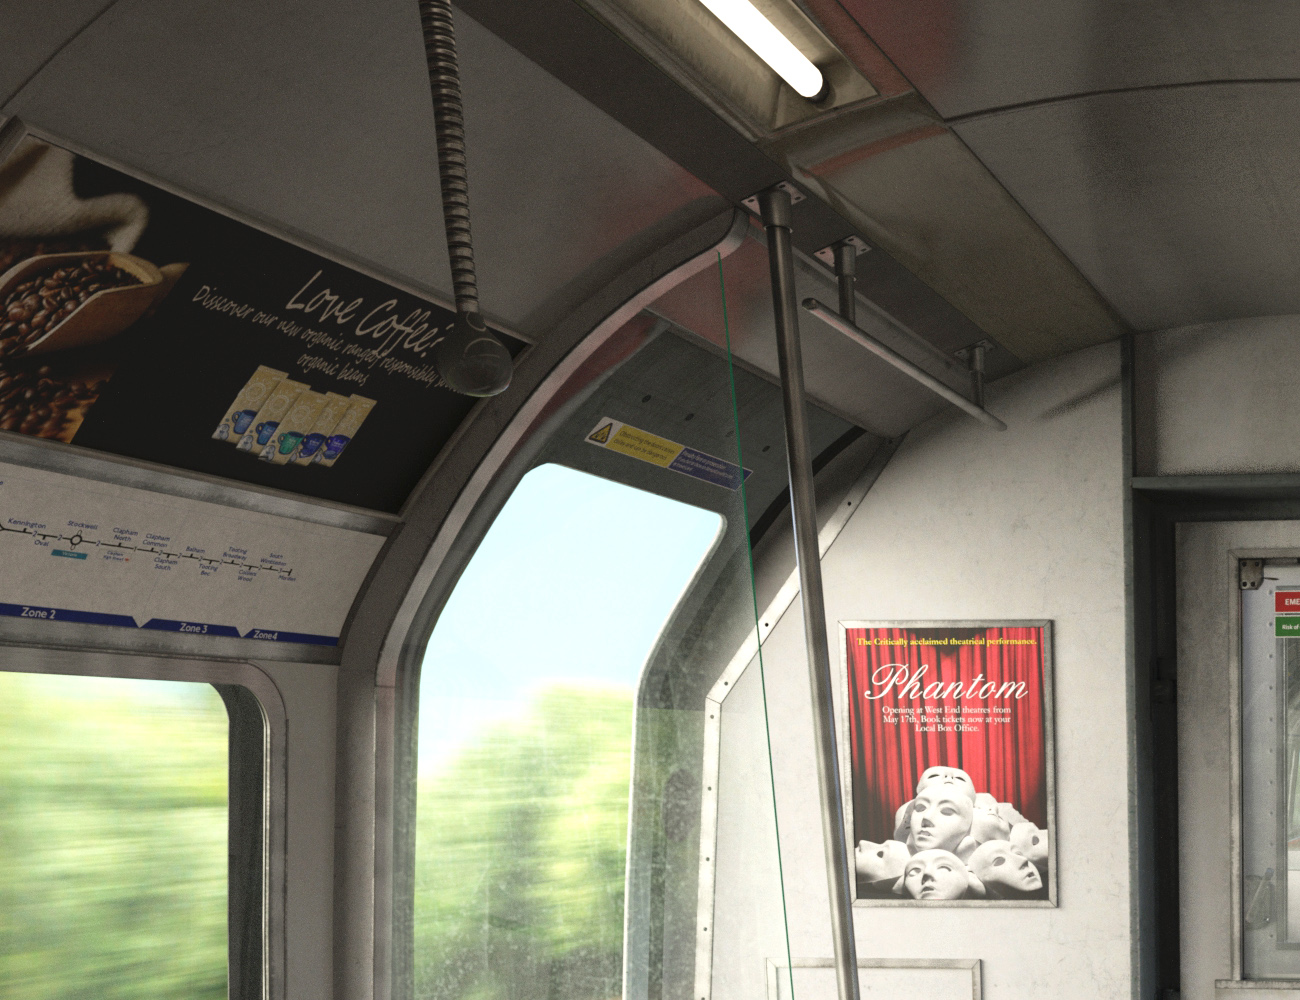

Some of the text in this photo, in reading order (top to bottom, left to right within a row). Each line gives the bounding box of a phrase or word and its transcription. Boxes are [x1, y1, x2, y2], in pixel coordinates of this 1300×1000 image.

[286, 269, 364, 325] Love
[192, 285, 254, 319] Disscover
[252, 311, 278, 328] our
[277, 319, 303, 338] new
[300, 328, 343, 350] organic
[297, 353, 370, 387] organic beans
[7, 517, 47, 530] Kennington
[67, 519, 99, 531] Stockwell
[112, 527, 139, 538] Clapham
[113, 534, 132, 542] North
[145, 533, 171, 543] Clapham
[34, 538, 50, 547] Oval
[142, 539, 168, 548] Common
[153, 556, 178, 566] Clapham
[154, 563, 172, 571] South
[21, 607, 56, 619] Zone 2
[180, 623, 208, 633] Zone 3
[856, 637, 1037, 648] The Critically acclaimed theatrical performance.
[864, 663, 1029, 700] Phantom
[882, 705, 1012, 716] Opening at West End theatres from
[882, 714, 1012, 726] May 17th, Book tickets now at your
[915, 723, 980, 732] Local Box Office.
